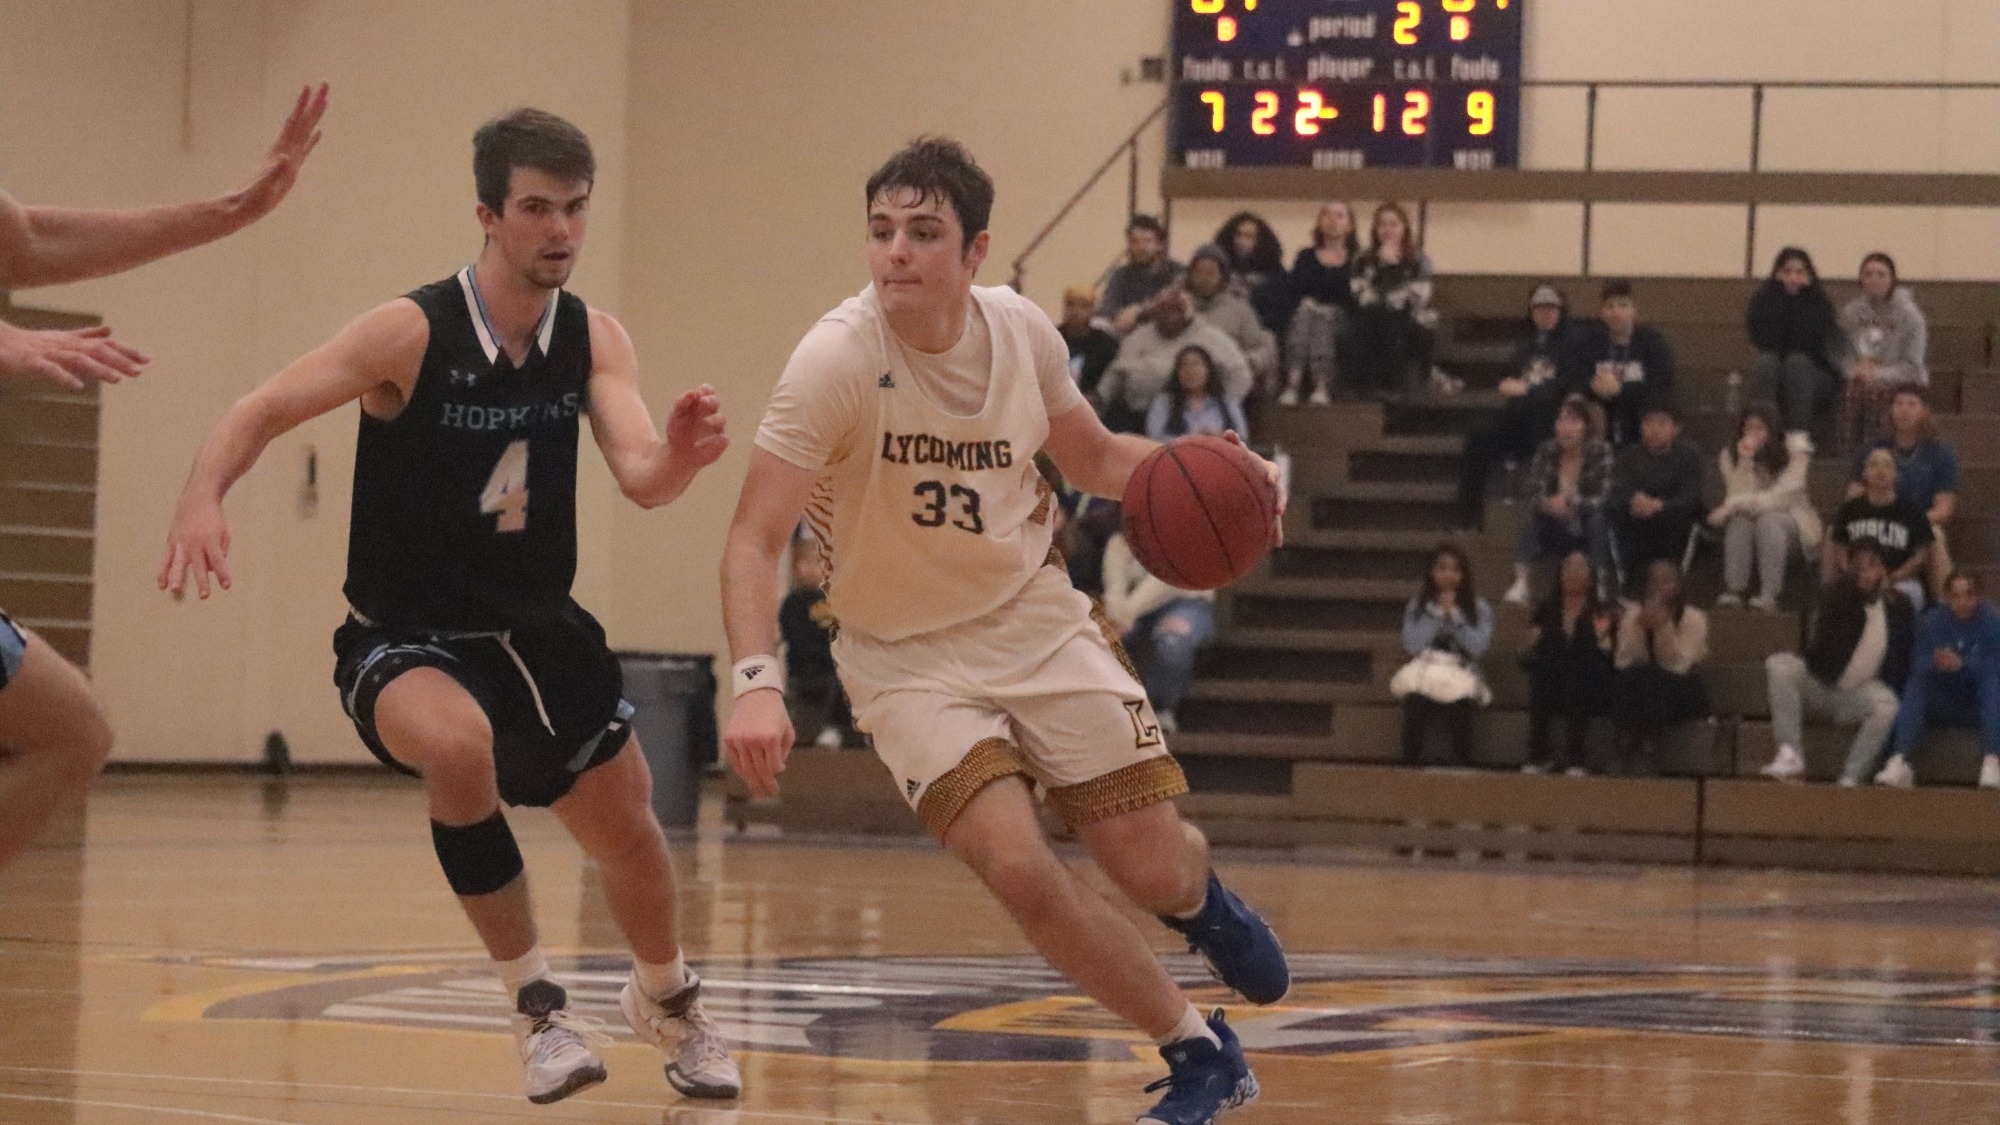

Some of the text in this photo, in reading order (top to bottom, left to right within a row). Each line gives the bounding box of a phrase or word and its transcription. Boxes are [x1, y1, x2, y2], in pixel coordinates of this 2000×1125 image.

[1393, 1, 1420, 44] 2
[1200, 91, 1224, 132] 7
[1466, 91, 1494, 135] 9
[881, 432, 1012, 471] LYCOMING
[480, 439, 529, 532] 4
[911, 480, 984, 535] 33
[1123, 700, 1161, 748] L
